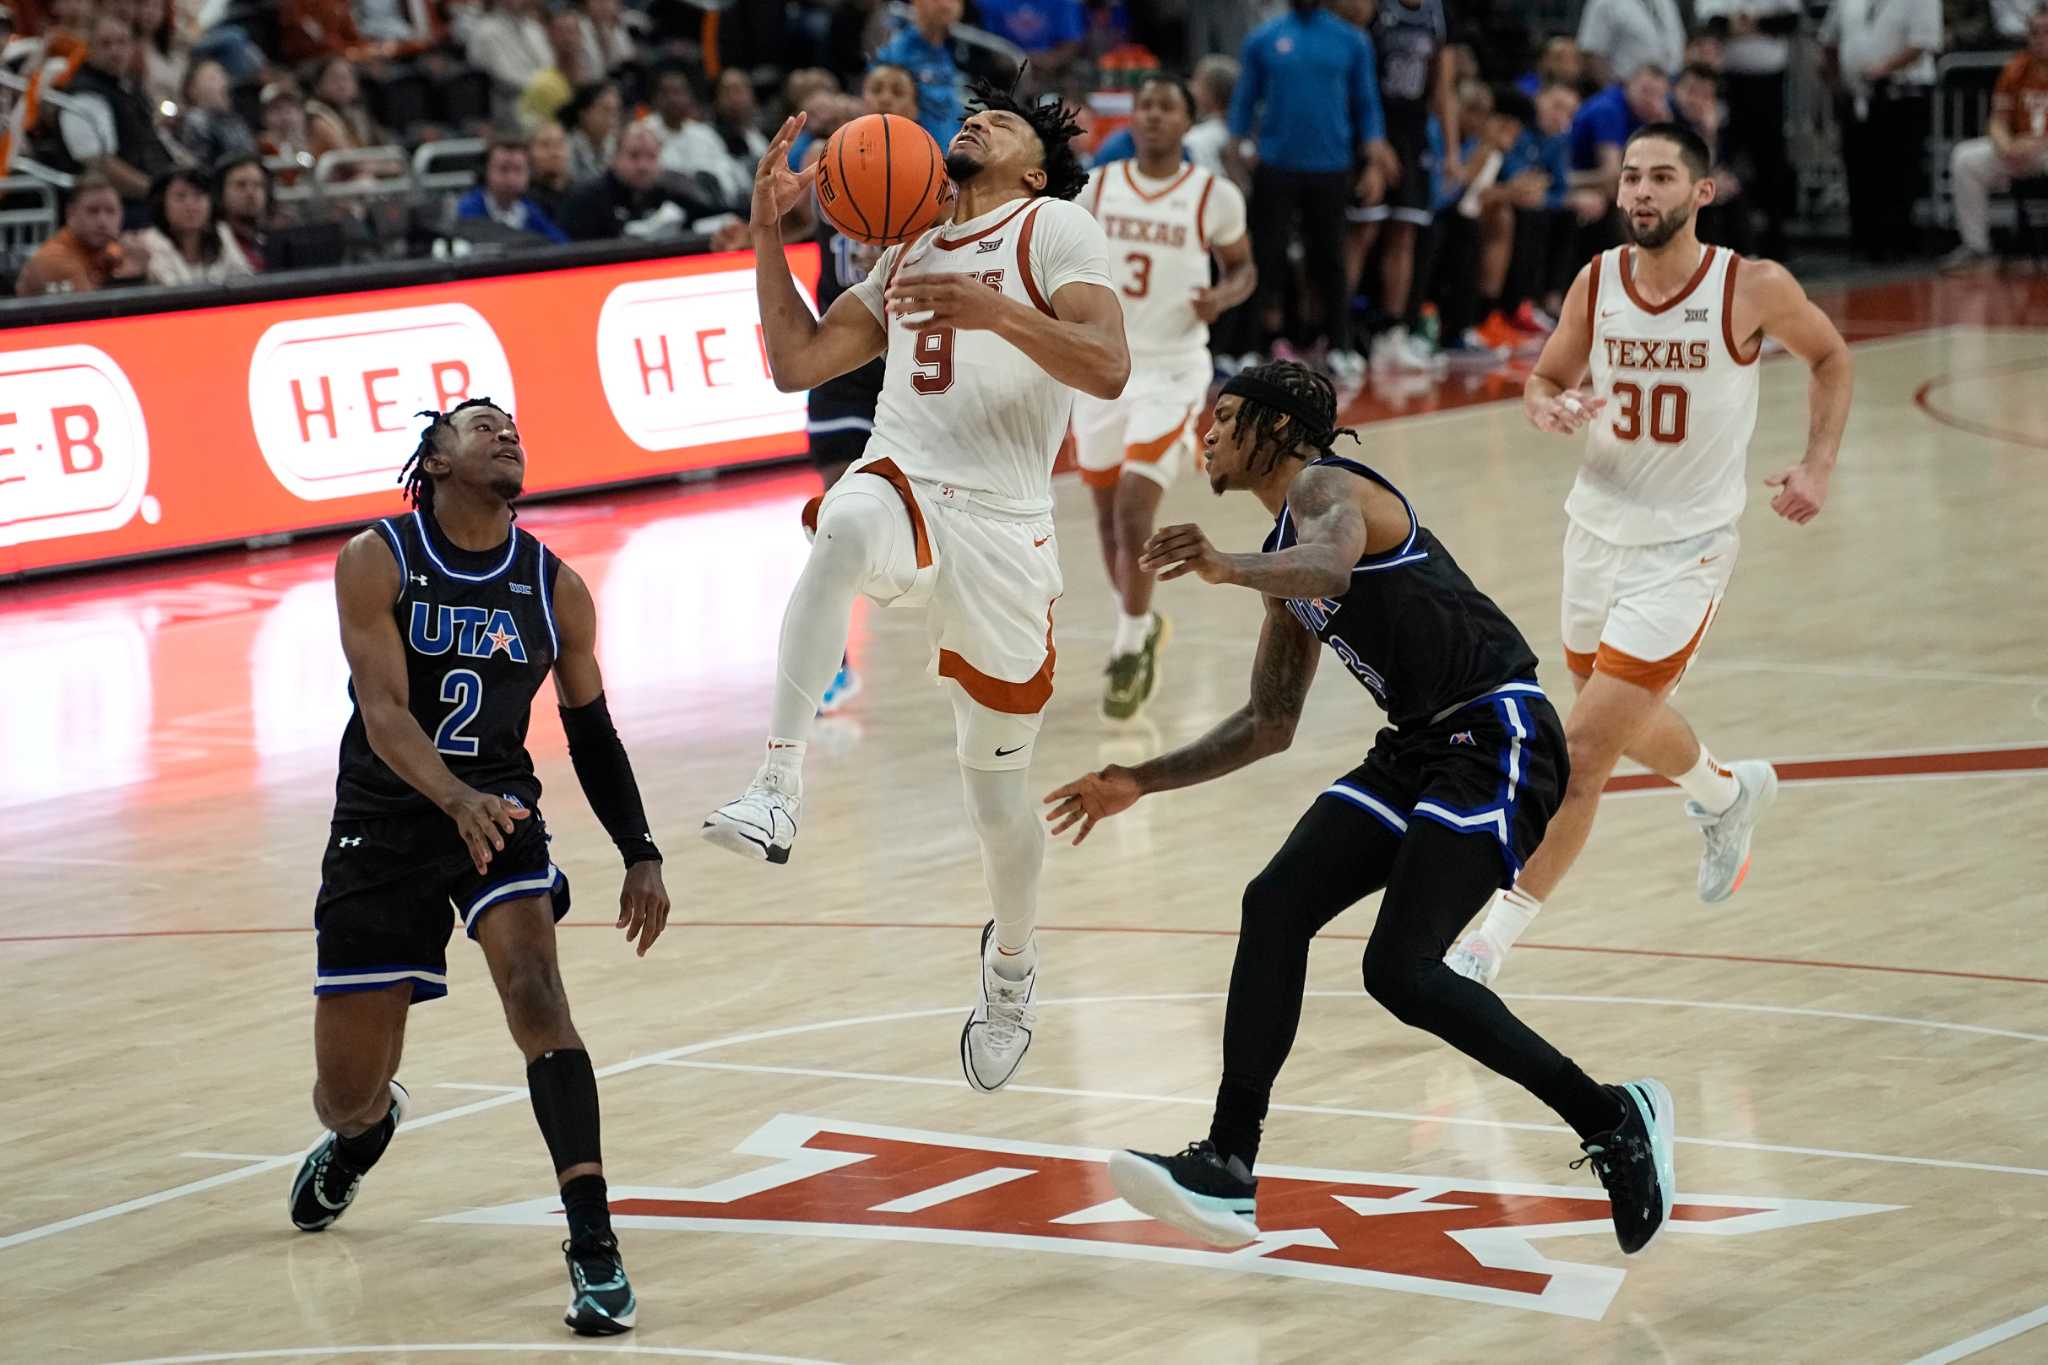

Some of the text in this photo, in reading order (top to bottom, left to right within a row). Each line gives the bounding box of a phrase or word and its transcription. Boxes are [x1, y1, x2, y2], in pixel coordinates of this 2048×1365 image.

[1105, 213, 1187, 249] TEXAS
[1122, 252, 1153, 300] 3
[910, 326, 957, 396] 9
[1604, 336, 1710, 372] TEXAS
[1611, 381, 1690, 443] 30
[409, 601, 528, 663] UTA
[434, 668, 483, 757] 2
